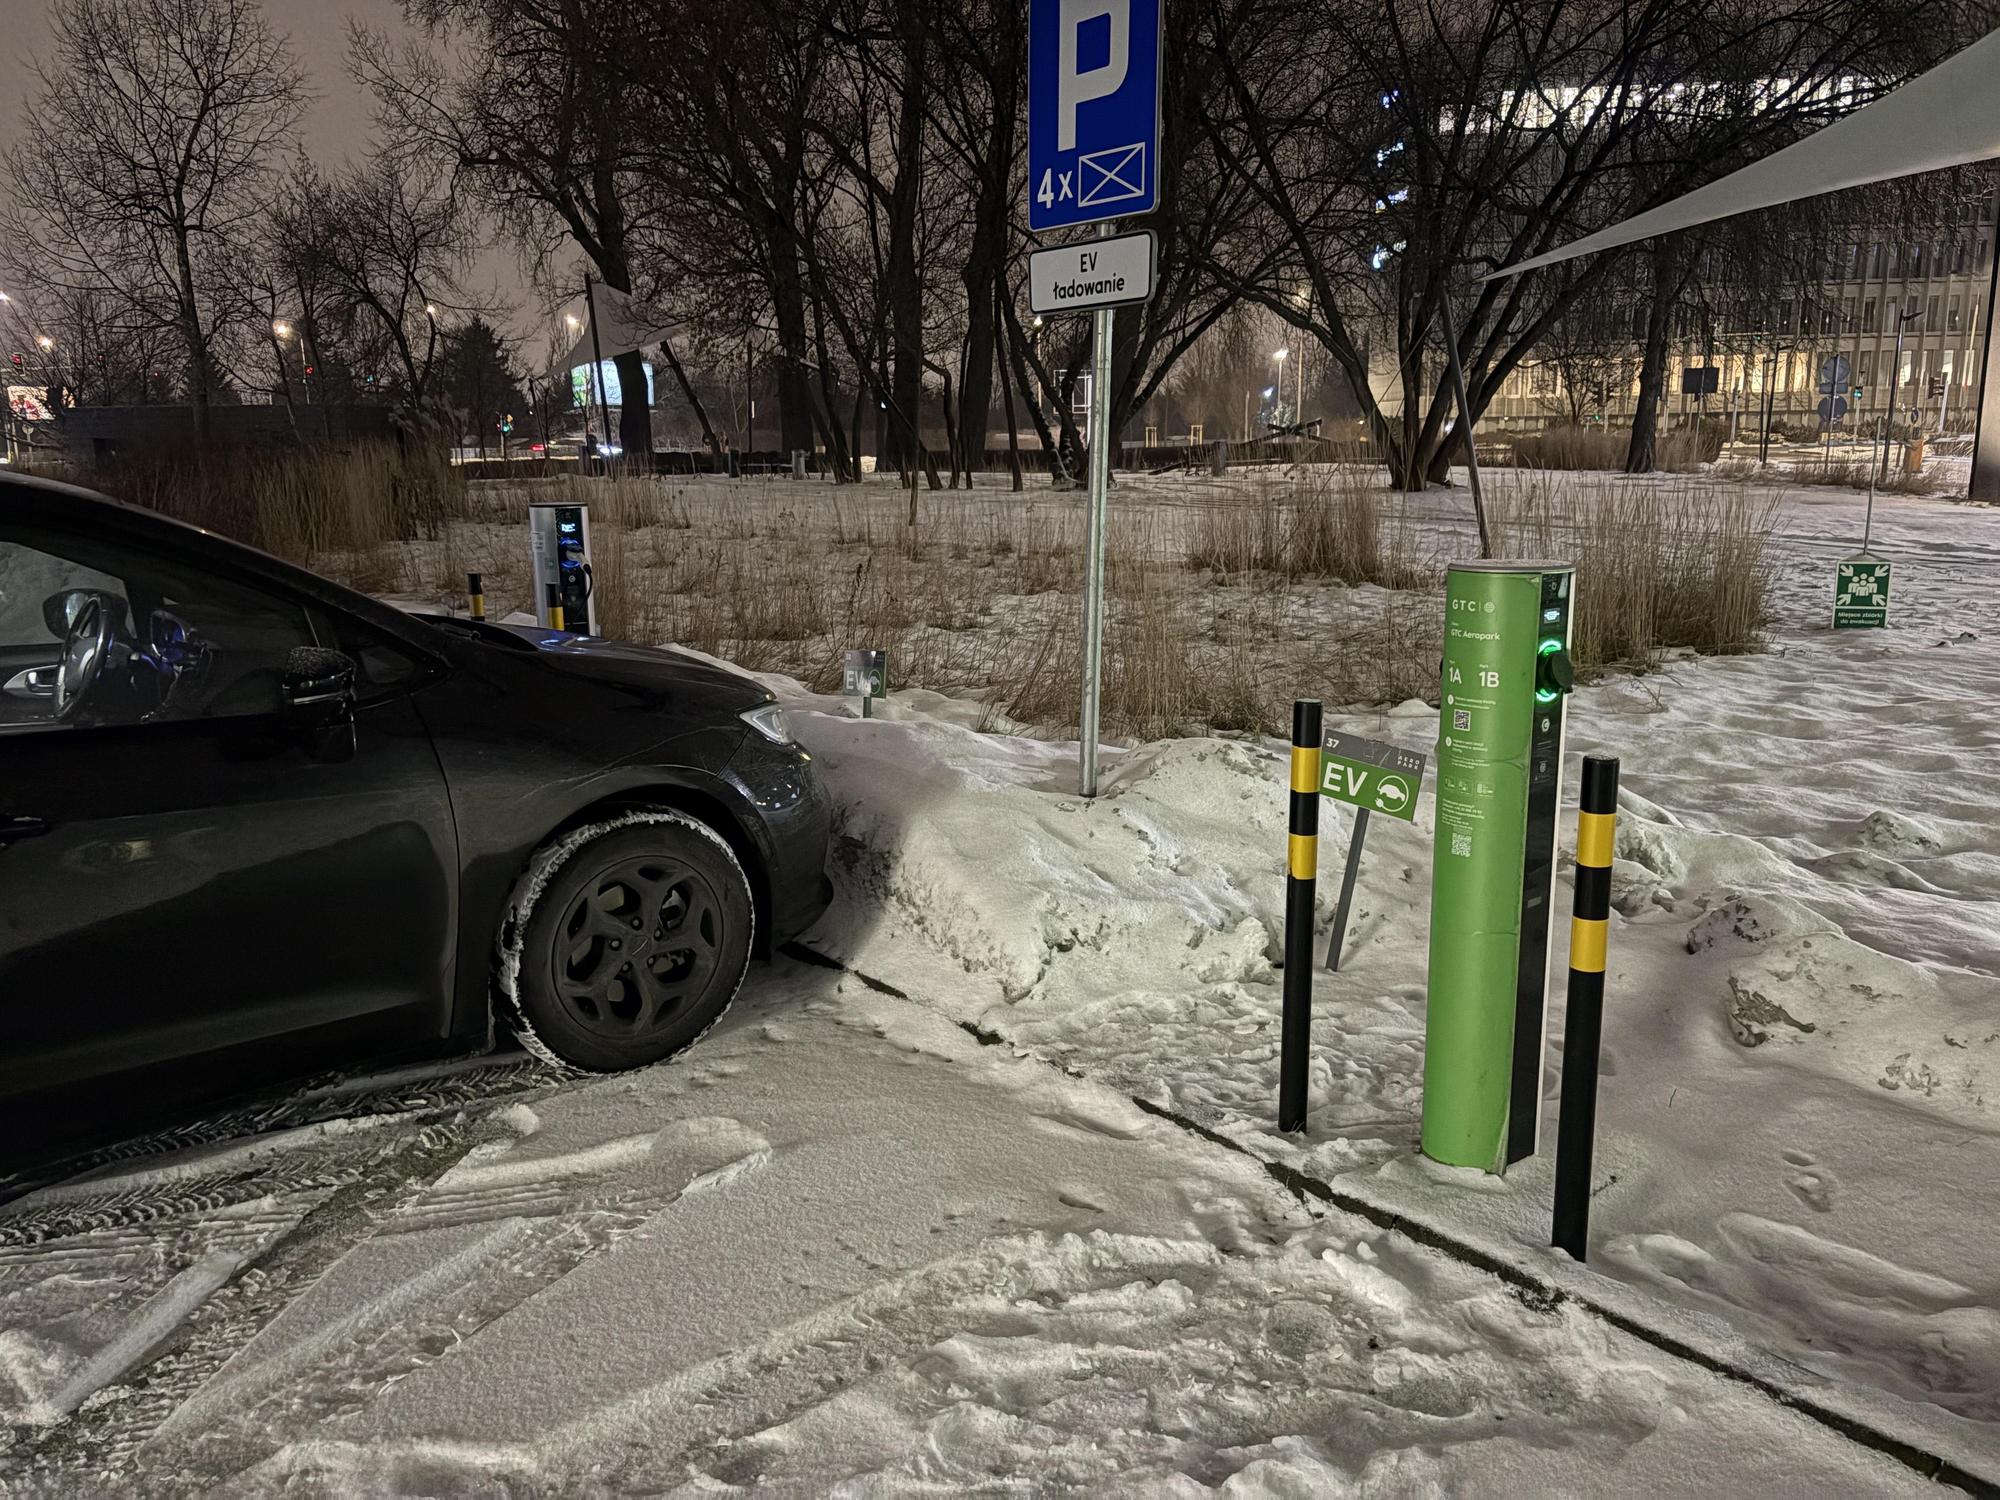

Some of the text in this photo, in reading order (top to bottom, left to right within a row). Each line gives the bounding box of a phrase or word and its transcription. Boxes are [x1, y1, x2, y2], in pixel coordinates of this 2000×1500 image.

[1058, 0, 1130, 152] P
[1037, 168, 1073, 209] 4x
[1080, 252, 1098, 273] EV
[1053, 273, 1125, 301] ładowanie
[1452, 599, 1476, 612] GTC
[1451, 629, 1500, 641] GTC Aeropark
[1449, 667, 1462, 684] 1A
[1478, 671, 1499, 688] 1B
[1326, 737, 1339, 749] 37
[1397, 755, 1420, 765] AERO
[1397, 761, 1418, 770] PARK
[1322, 761, 1368, 797] EV
